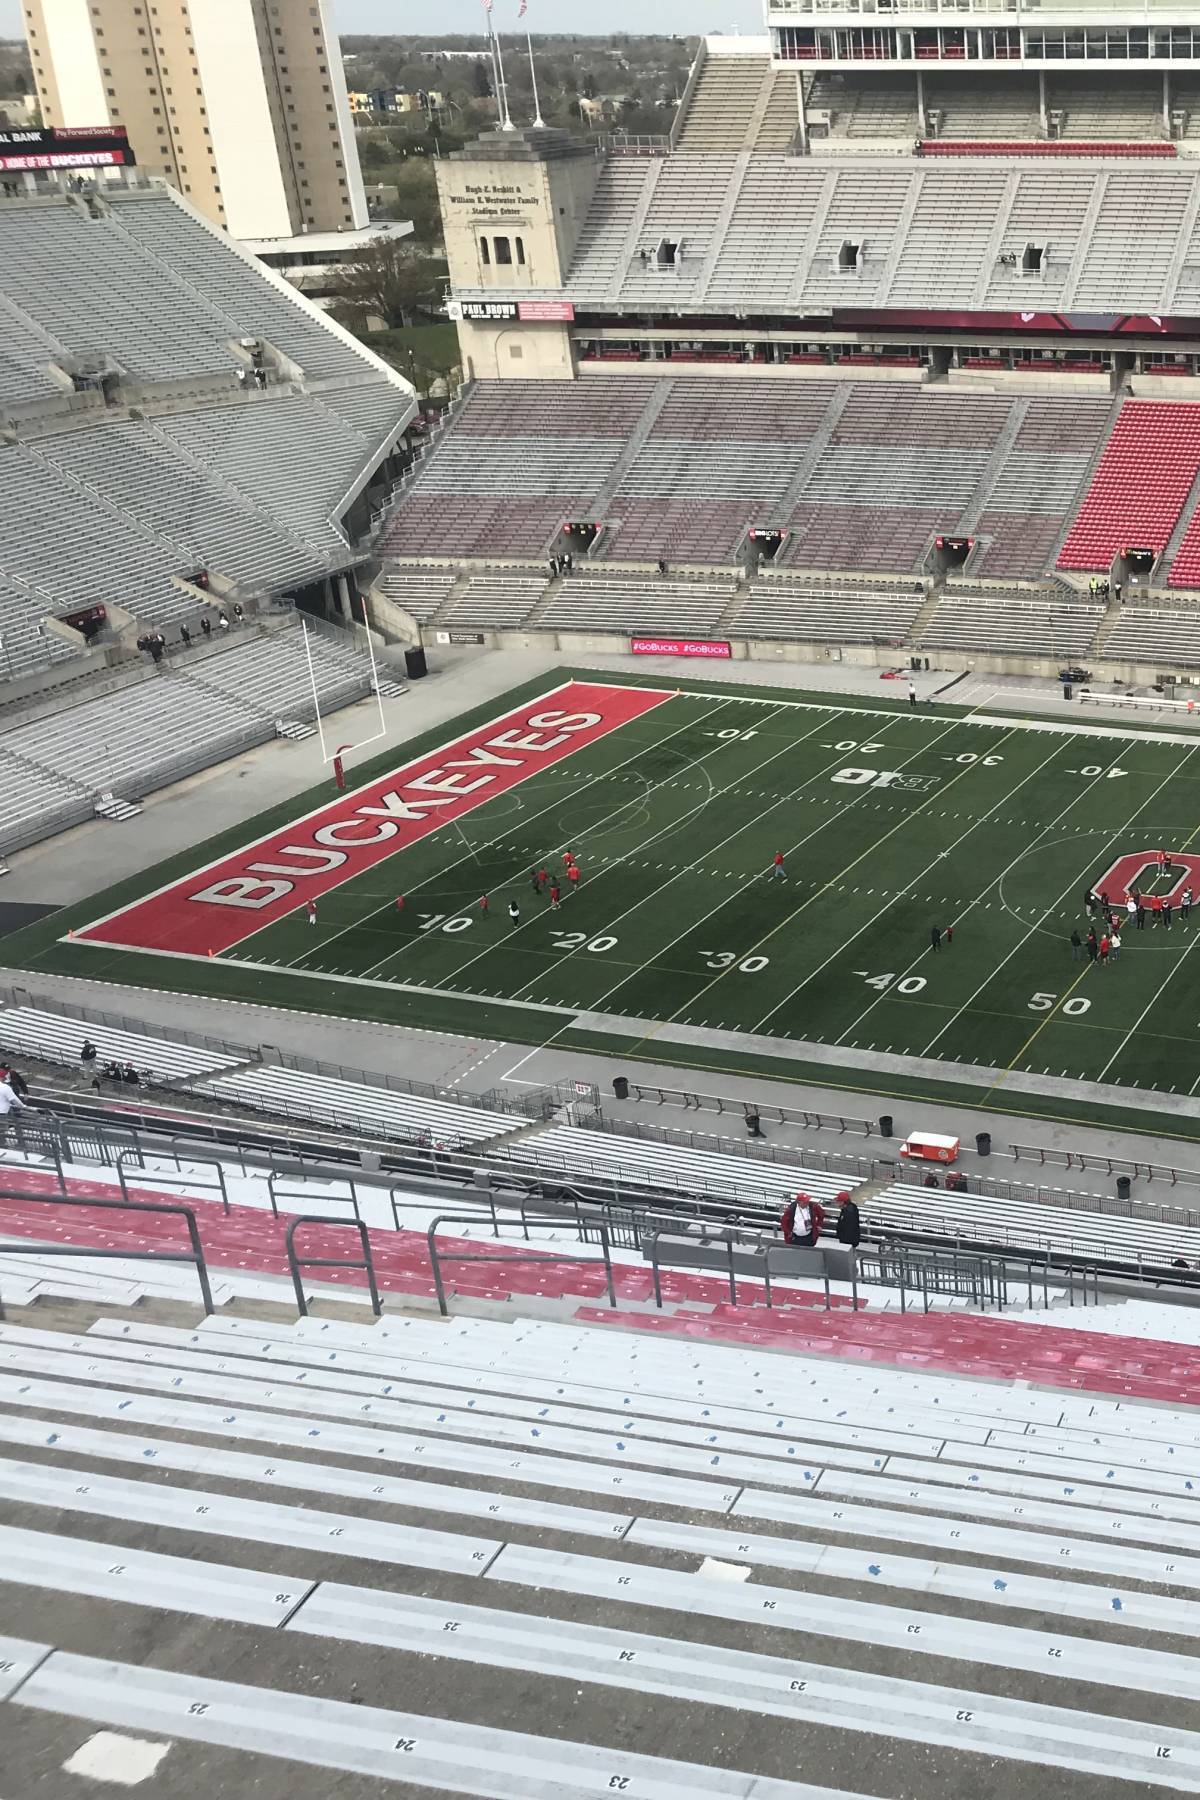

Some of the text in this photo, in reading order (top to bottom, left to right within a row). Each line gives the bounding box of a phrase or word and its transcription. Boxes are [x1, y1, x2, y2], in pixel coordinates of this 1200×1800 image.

[11, 132, 42, 143] BANK
[5, 152, 114, 169] HOME OF THE BUCKEYES
[450, 196, 475, 204] William
[472, 207, 521, 216] Stadium Center
[462, 304, 484, 315] PAUL
[485, 304, 516, 315] BROWN
[717, 728, 759, 742] 10
[835, 740, 886, 754] 20
[955, 752, 1005, 767] 30
[1080, 765, 1130, 780] 40
[188, 709, 603, 910] BUCKEYES
[418, 914, 474, 934] 10
[551, 931, 619, 953] 20
[706, 951, 770, 974] 30
[864, 972, 928, 995] 40
[1027, 992, 1092, 1016] 50
[613, 1525, 625, 1534] 25
[107, 1565, 127, 1575] 27
[617, 1576, 632, 1585] 25
[275, 1593, 292, 1604] 26
[762, 1600, 777, 1610] 24
[442, 1621, 462, 1632] 25
[907, 1624, 922, 1634] 23
[618, 1650, 636, 1662] 24
[1047, 1647, 1062, 1658] 22
[790, 1680, 807, 1691] 23
[188, 1702, 210, 1715] 25
[956, 1710, 975, 1722] 22
[394, 1738, 417, 1752] 24
[1156, 1746, 1171, 1759] 21
[608, 1775, 631, 1790] 23
